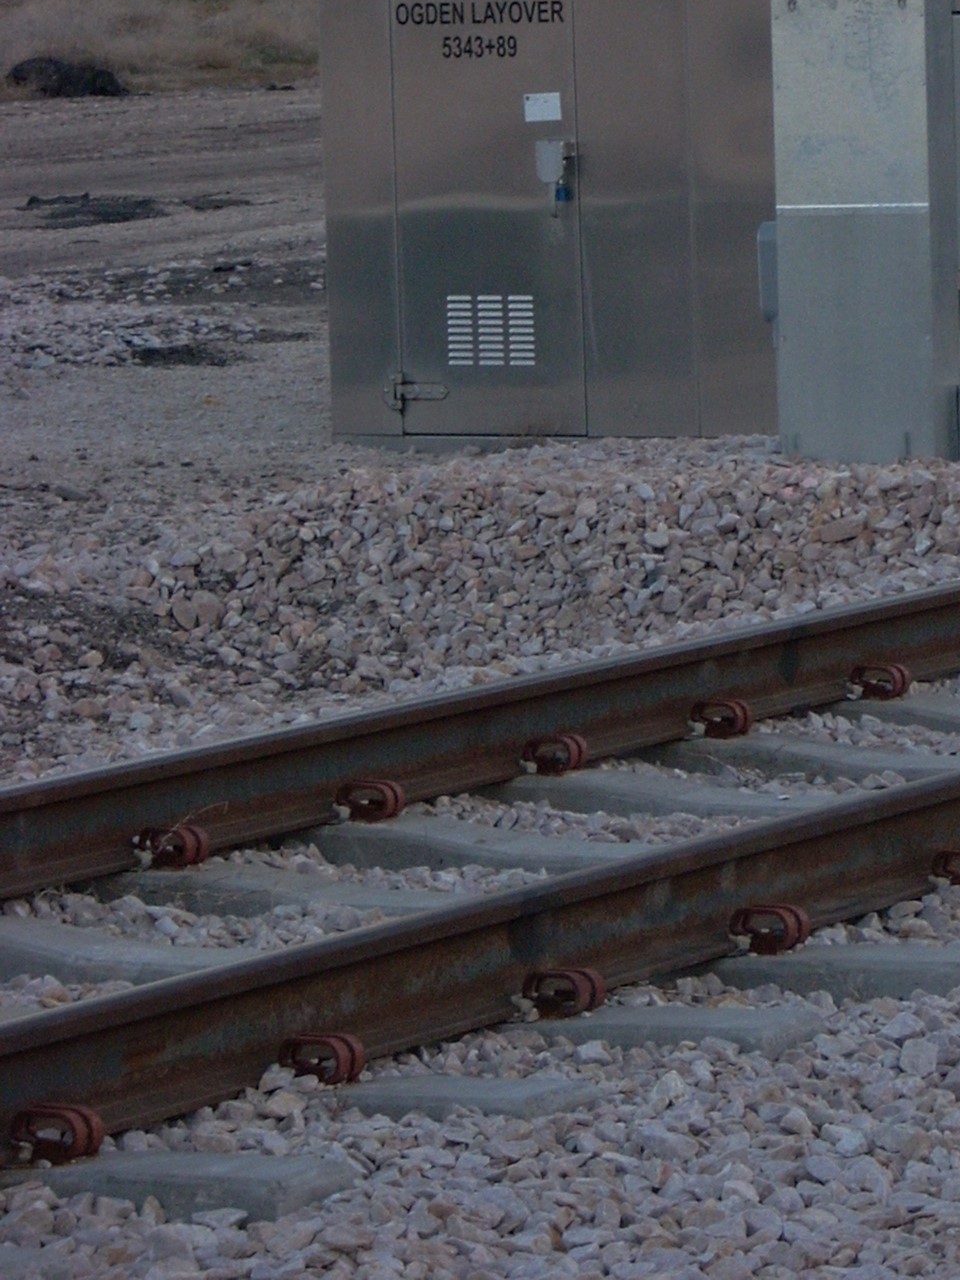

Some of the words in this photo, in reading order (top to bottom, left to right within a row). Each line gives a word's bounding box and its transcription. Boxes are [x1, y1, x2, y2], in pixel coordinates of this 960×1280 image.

[395, 2, 464, 25] OGDEN
[471, 0, 564, 24] LAYOVER
[442, 35, 518, 58] 5343+89
